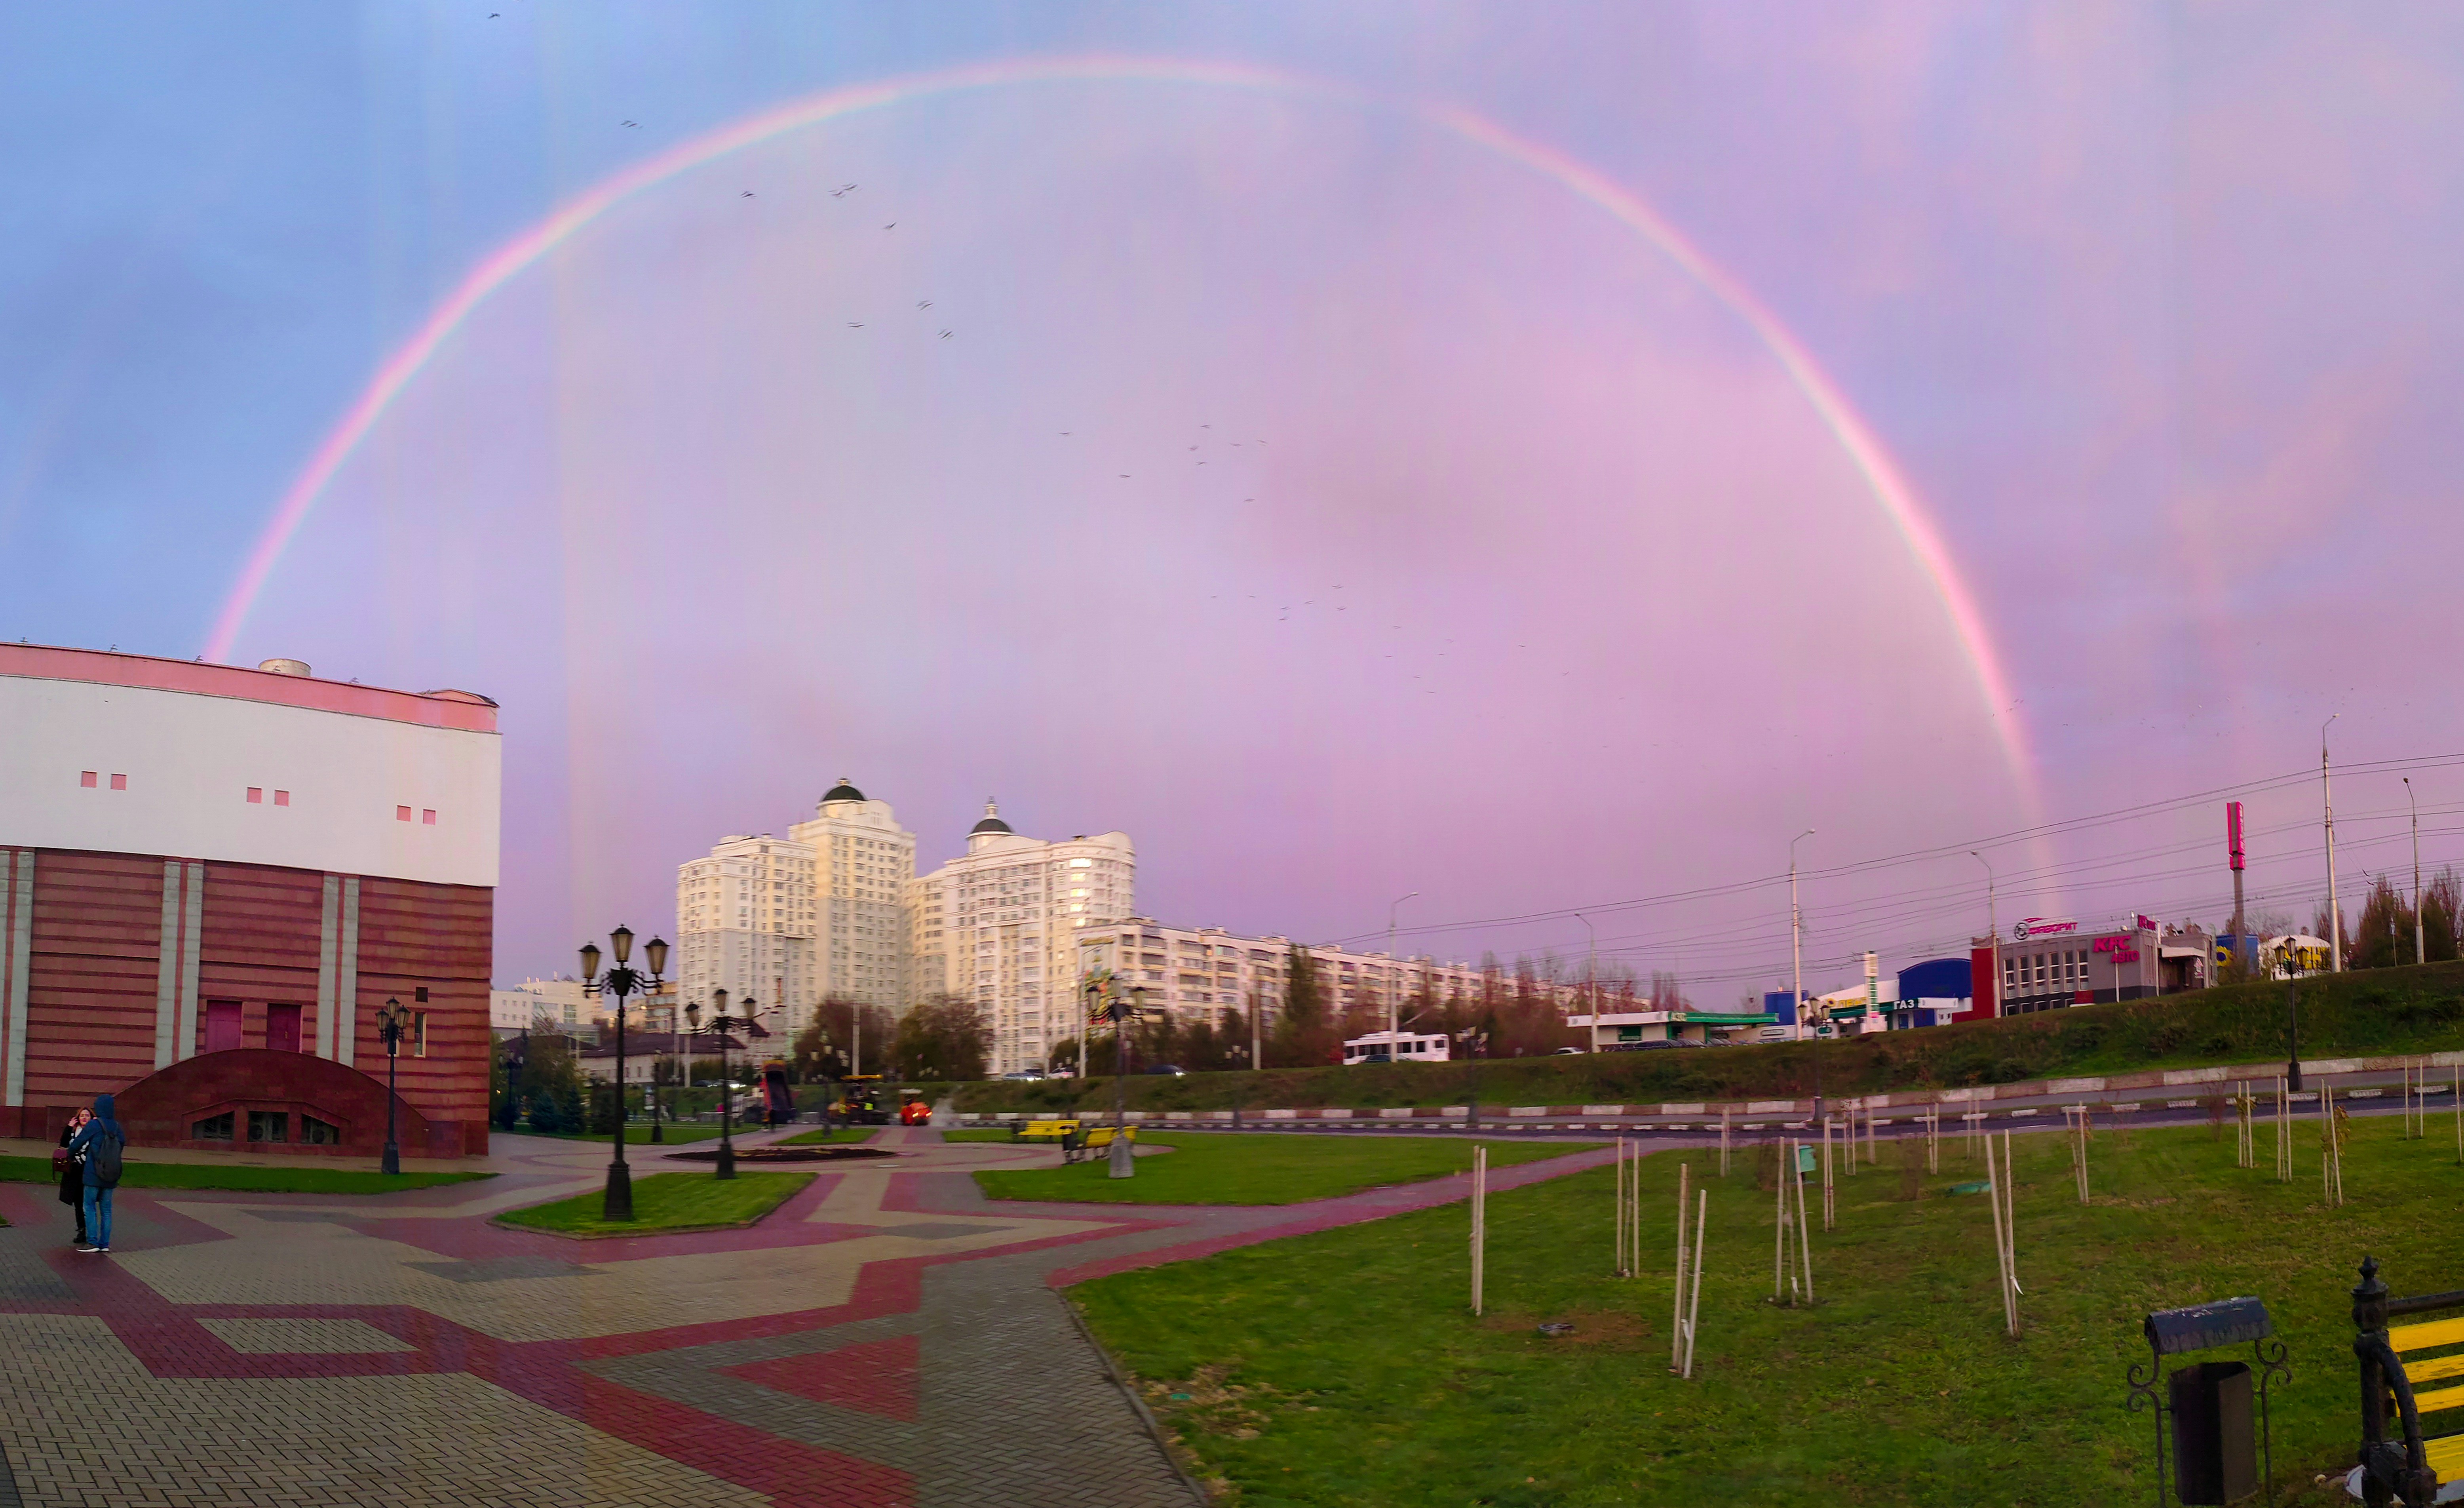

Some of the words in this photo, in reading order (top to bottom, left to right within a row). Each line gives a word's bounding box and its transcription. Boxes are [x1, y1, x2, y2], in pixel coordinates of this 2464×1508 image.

[2093, 935, 2131, 952] KFC
[2111, 950, 2139, 963] АВТО
[1894, 1000, 1915, 1009] ГАЗ
